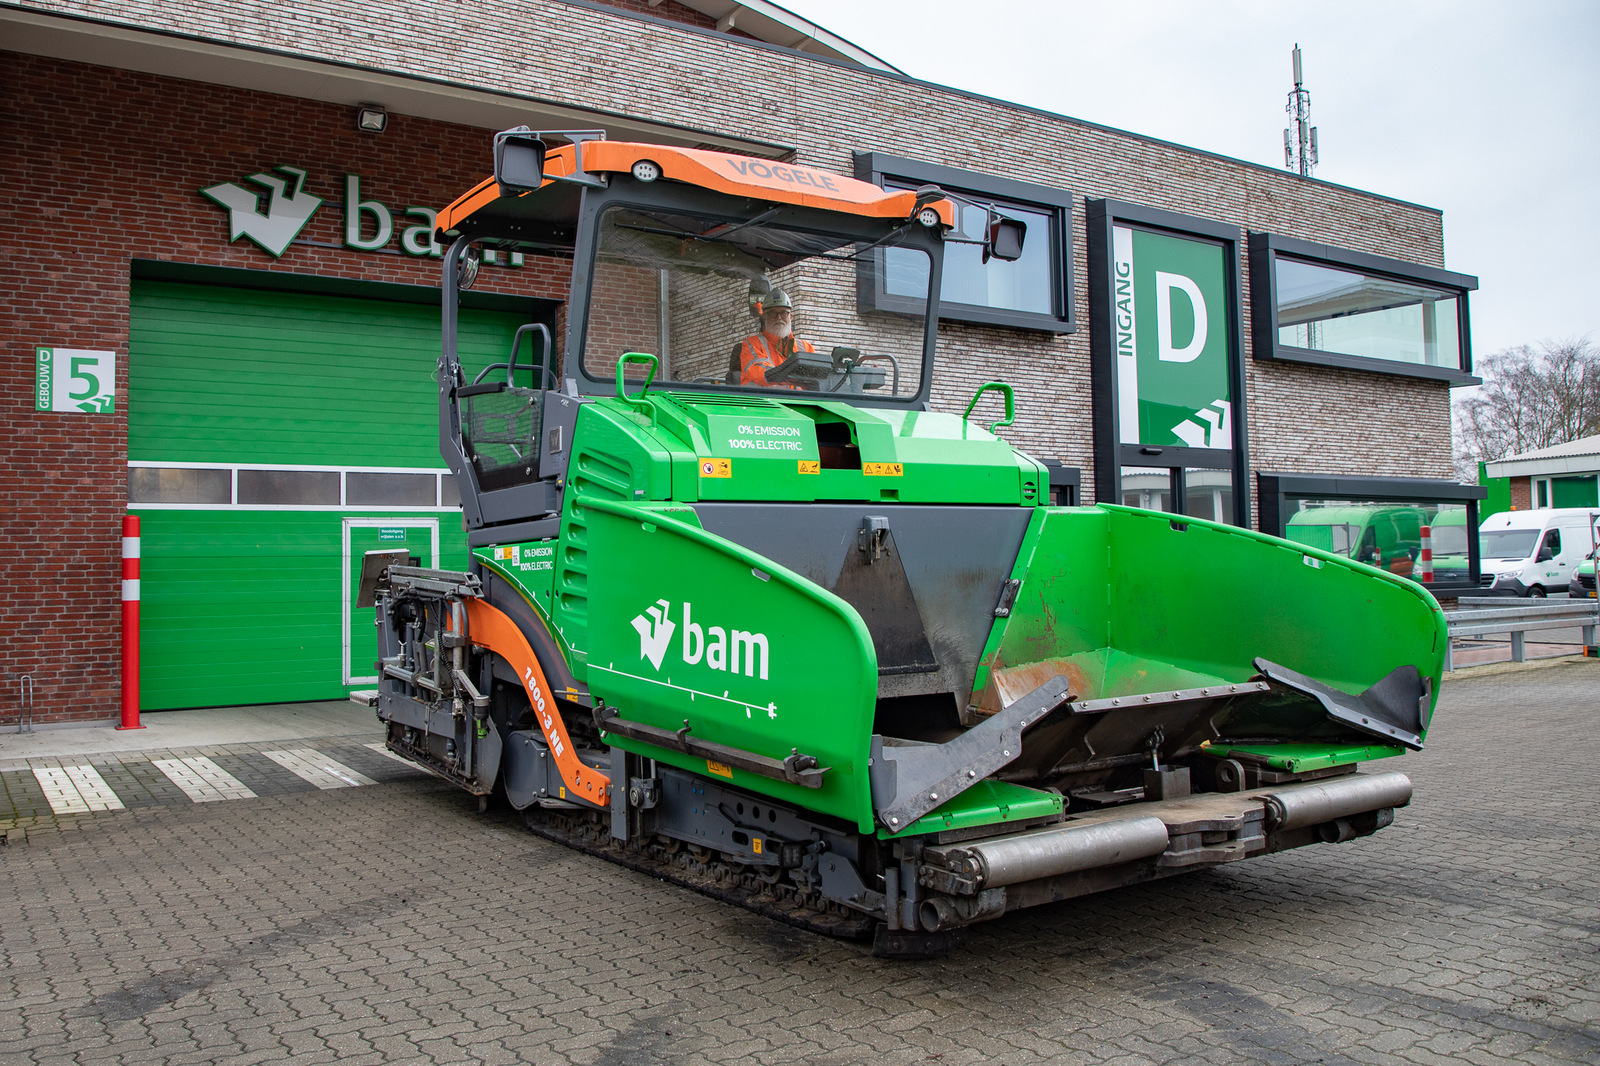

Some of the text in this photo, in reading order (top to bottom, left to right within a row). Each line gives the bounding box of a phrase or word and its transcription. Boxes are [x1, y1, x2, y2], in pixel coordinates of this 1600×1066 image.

[726, 158, 840, 193] VÖGELE
[345, 172, 525, 267] ba
[1115, 261, 1133, 357] INGANG
[1155, 270, 1208, 363] D
[39, 350, 51, 409] GEBOUW D
[68, 356, 100, 401] 5
[728, 438, 803, 451] 100% ELECTRIC
[738, 424, 800, 437] 0% EMISSION
[520, 560, 553, 571] 100% ELECTRIC
[531, 547, 553, 557] EMISSION
[682, 601, 769, 681] bam
[525, 666, 565, 758] 1800-3 NE
